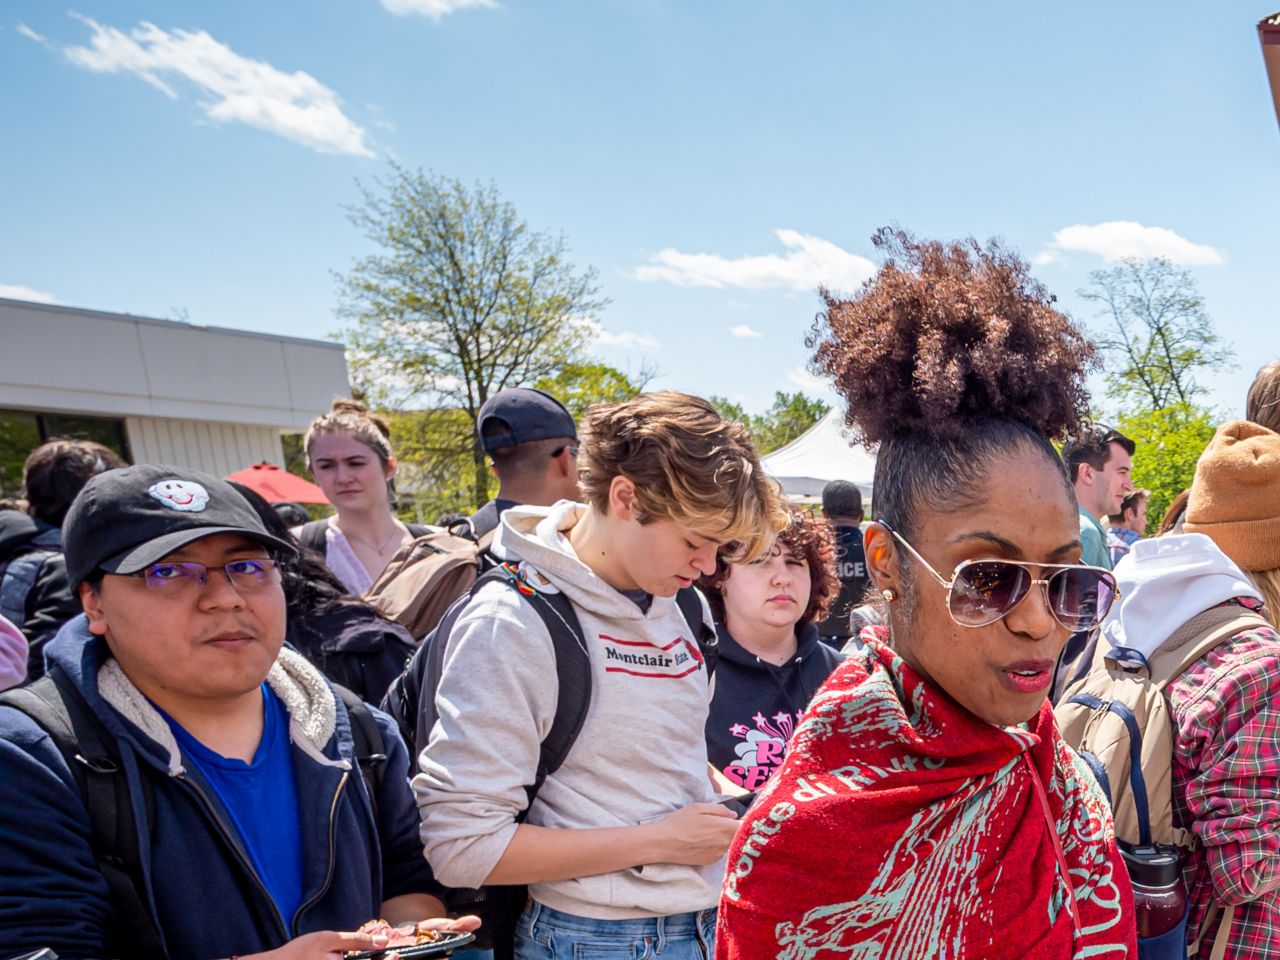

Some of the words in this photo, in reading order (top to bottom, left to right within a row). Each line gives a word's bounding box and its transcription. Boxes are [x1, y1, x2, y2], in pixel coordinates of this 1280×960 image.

[838, 561, 864, 577] ICE
[605, 647, 672, 667] Montclair
[726, 801, 796, 900] Ponte
[793, 774, 836, 802] di
